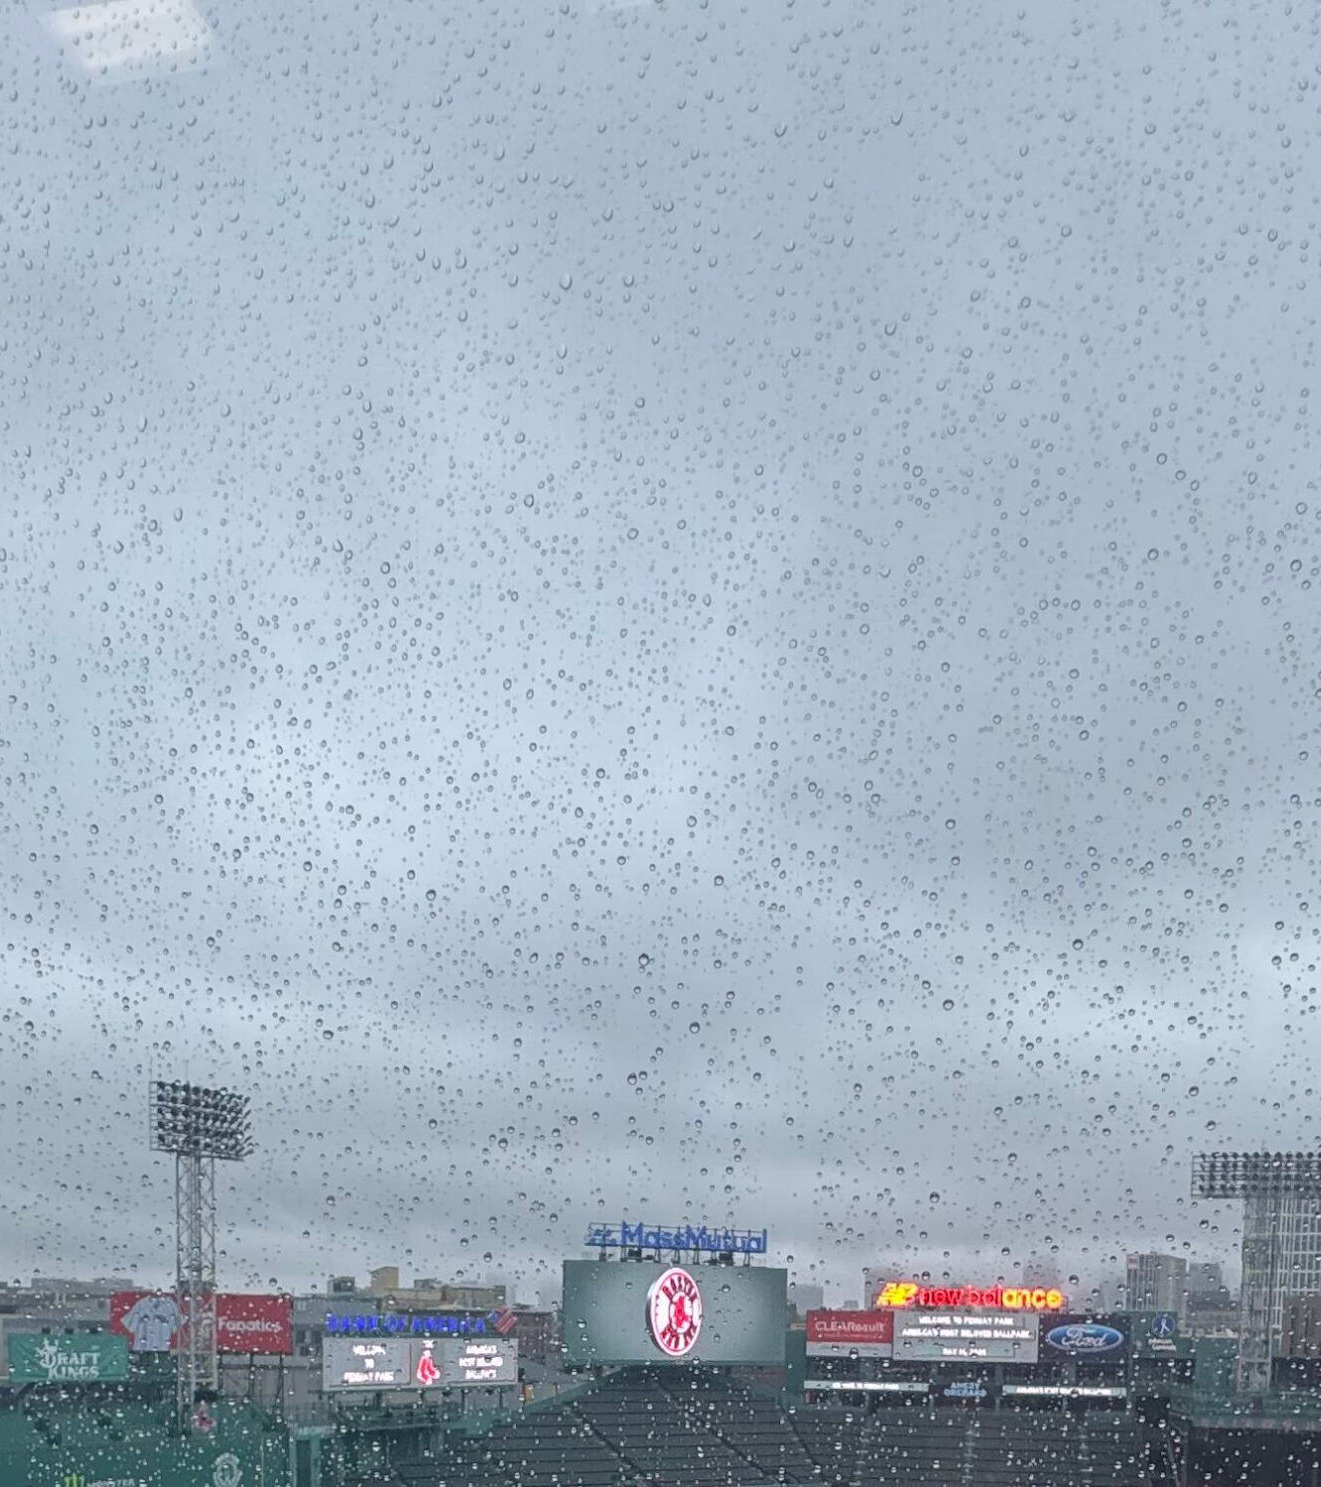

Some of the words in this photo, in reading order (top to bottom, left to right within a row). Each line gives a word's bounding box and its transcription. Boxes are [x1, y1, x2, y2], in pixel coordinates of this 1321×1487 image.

[621, 1220, 768, 1253] MassMutual
[920, 1287, 964, 1306] new
[968, 1283, 1064, 1309] balance
[217, 1316, 283, 1333] Fanatics
[327, 1314, 379, 1333] BANK
[384, 1314, 408, 1333] OF
[1061, 1327, 1112, 1348] Ford
[40, 1350, 100, 1368] DRAFT
[48, 1365, 100, 1379] KINGS
